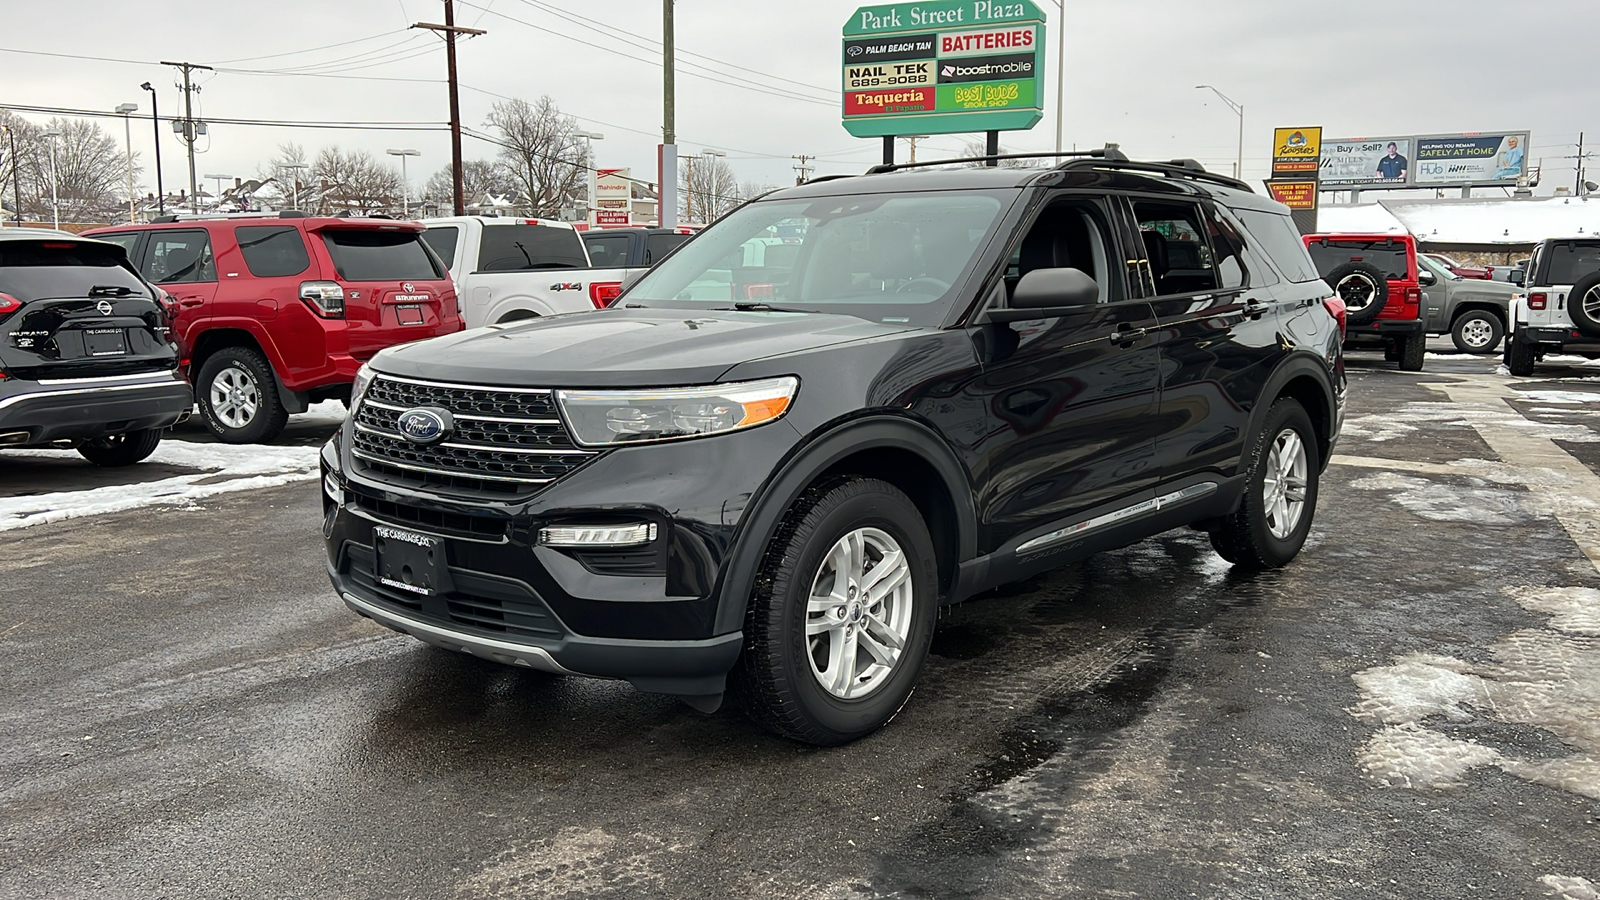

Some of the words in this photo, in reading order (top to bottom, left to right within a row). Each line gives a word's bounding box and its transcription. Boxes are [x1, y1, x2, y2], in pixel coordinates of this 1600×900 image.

[861, 8, 902, 29] Park
[910, 6, 963, 26] Street
[974, 0, 1024, 20] Plaza
[865, 44, 887, 54] PALM
[887, 42, 914, 53] BEACH
[916, 41, 932, 50] TAN
[942, 30, 1033, 52] BATTERIES
[849, 66, 887, 78] NAIL
[894, 63, 928, 75] TEK
[851, 75, 928, 88] 689-9088
[984, 82, 1019, 102] BUDZ
[963, 100, 988, 108] SMOKE
[988, 99, 1009, 107] SHOP
[1279, 145, 1314, 156] Roosters
[1336, 145, 1353, 154] Buy
[1362, 143, 1383, 152] Sell?
[1420, 149, 1452, 157] SAFELY
[1452, 148, 1465, 156] AT
[1466, 147, 1494, 155] HOME
[1421, 164, 1443, 174] Hub
[405, 414, 432, 434] Ford
[376, 527, 390, 539] THE
[389, 529, 420, 544] CARRIAGE
[420, 536, 431, 547] CO.
[380, 577, 429, 596] CARRIAGECOMPANY.COM
